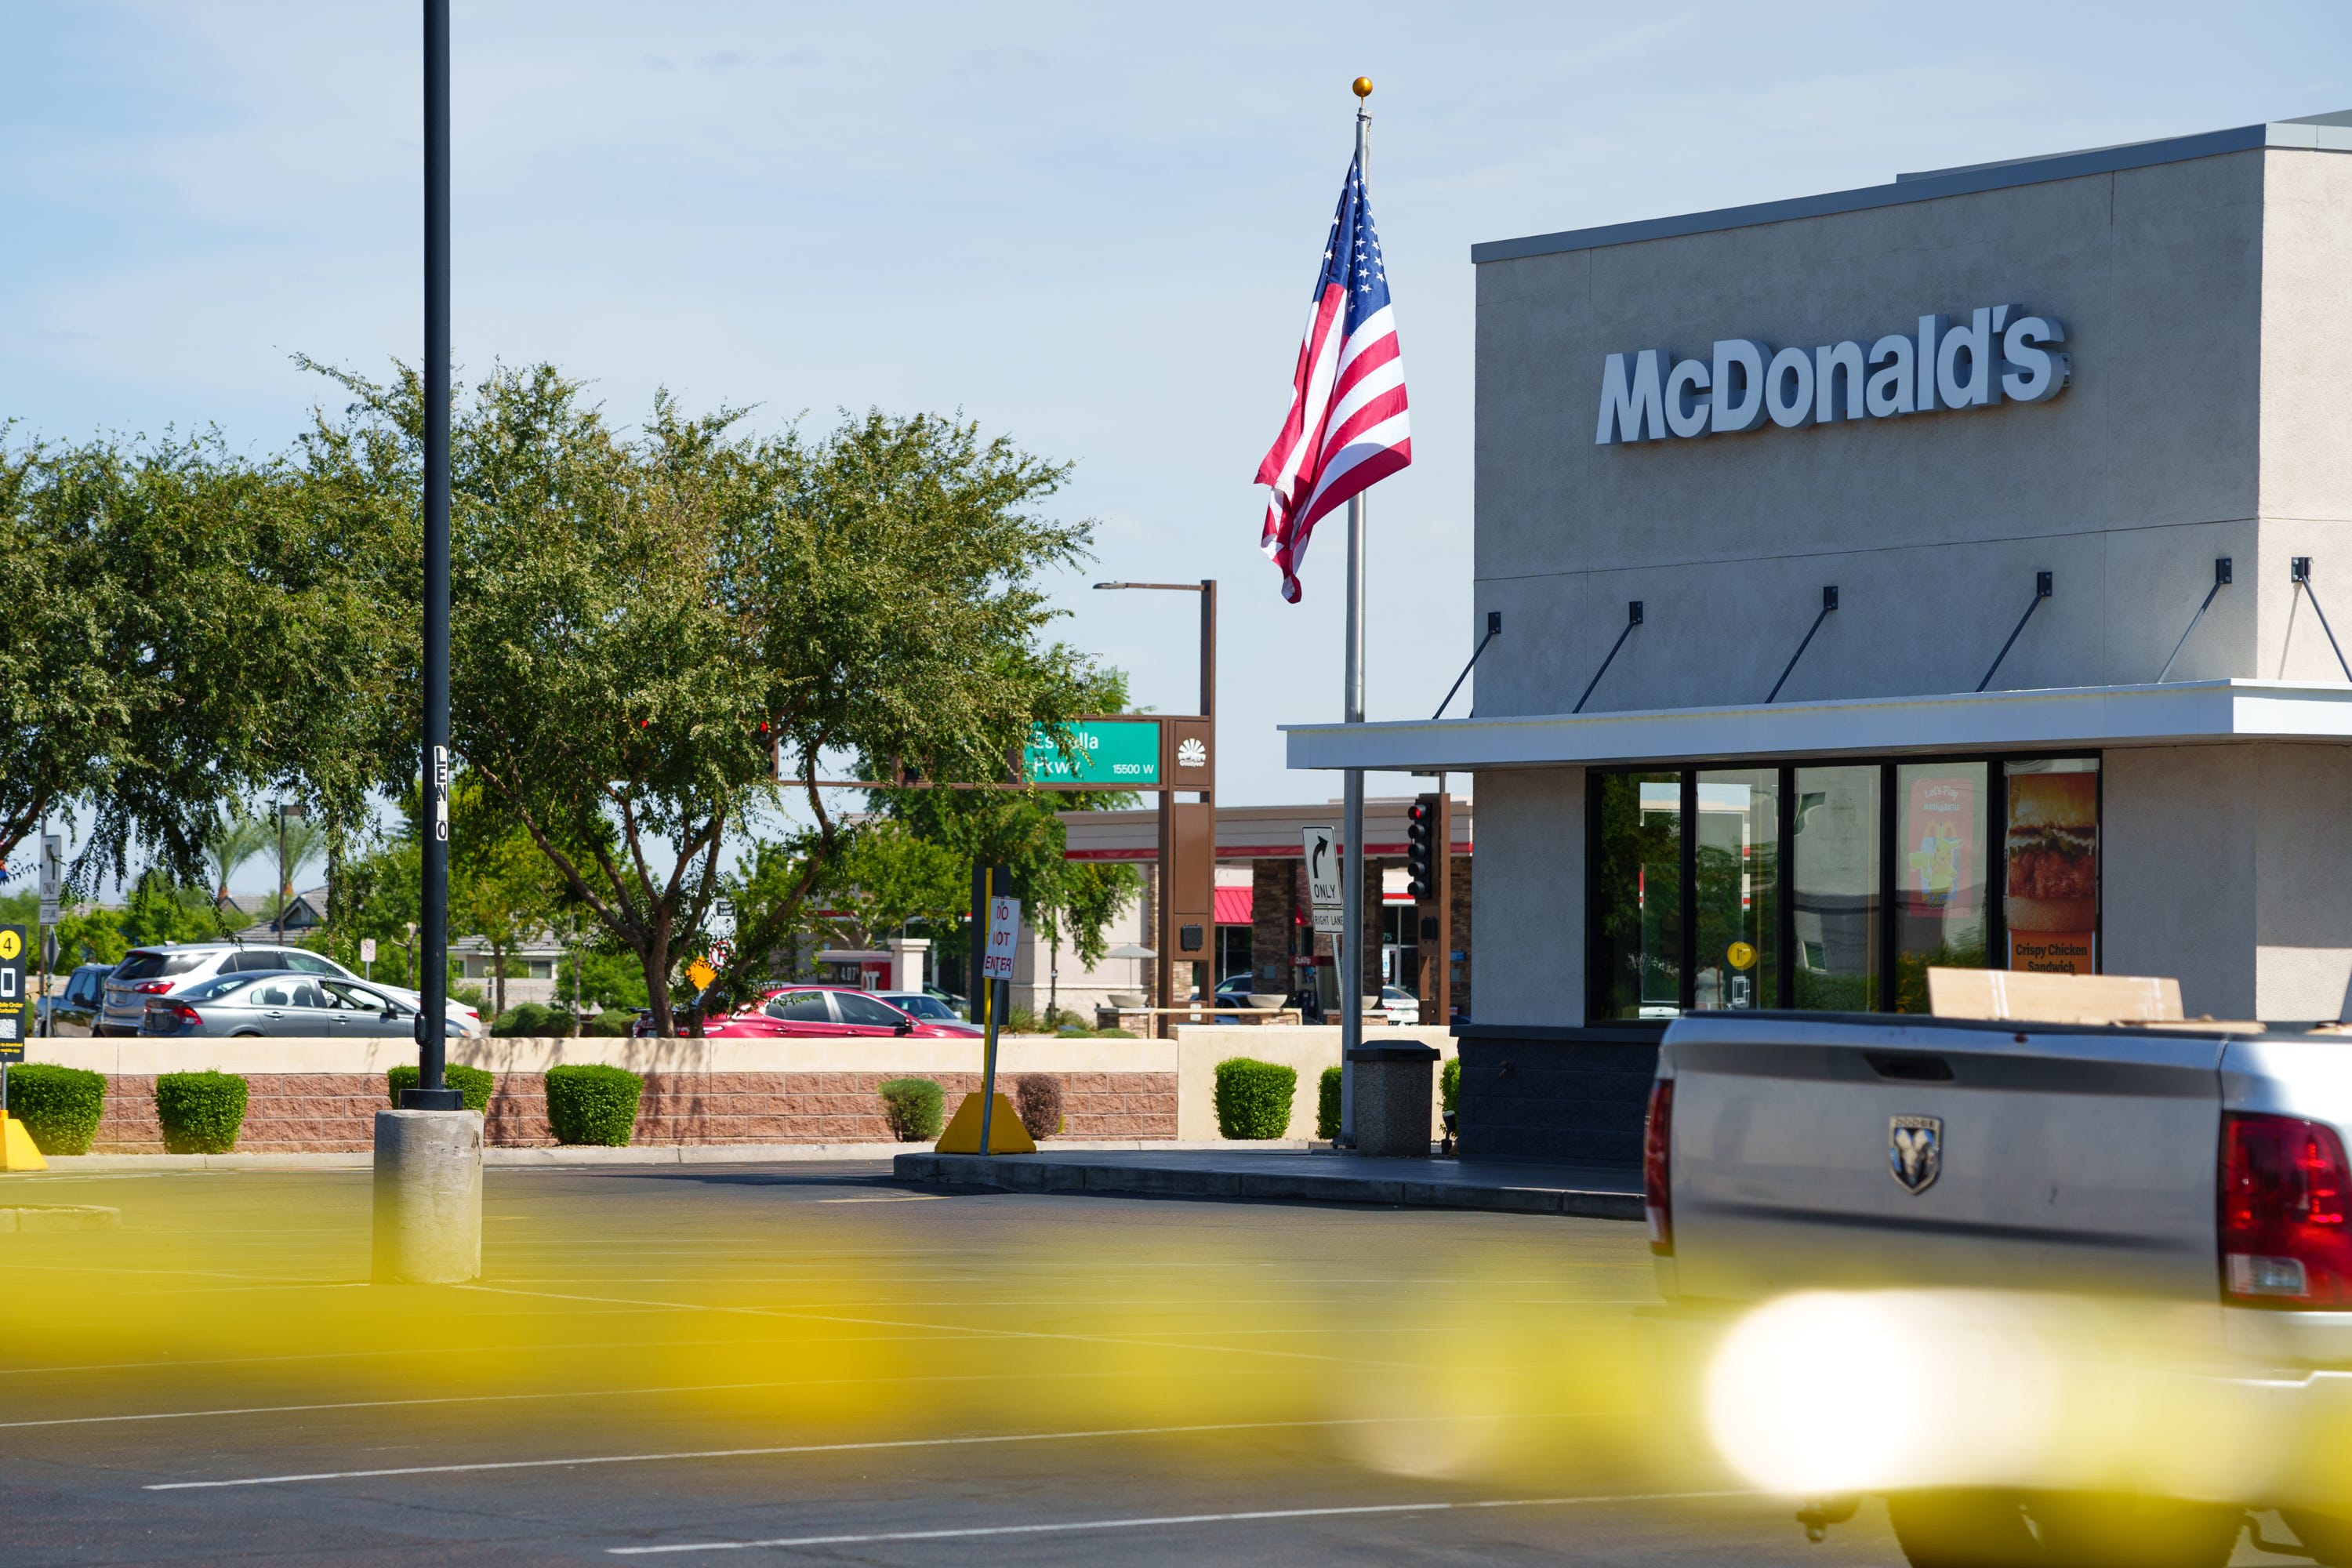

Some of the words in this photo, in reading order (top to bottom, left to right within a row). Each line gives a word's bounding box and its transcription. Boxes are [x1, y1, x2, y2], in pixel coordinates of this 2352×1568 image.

[1595, 303, 2067, 445] McDonald's
[1033, 731, 1099, 750] Eslla
[1113, 764, 1140, 775] 15500
[1142, 764, 1154, 775] W
[1925, 785, 1943, 798] Let's
[1943, 784, 1958, 801] Play
[42, 882, 56, 895] ONLY
[1314, 884, 1336, 898] ONLY
[996, 905, 1009, 920] DO
[1314, 915, 1329, 926] RIGHT
[1330, 915, 1344, 926] LANE
[3, 937, 13, 952] 4
[2016, 942, 2046, 959] Crispy
[2048, 942, 2087, 956] Chicken
[985, 955, 1012, 972] ENTER
[2027, 960, 2075, 973] Sandwich
